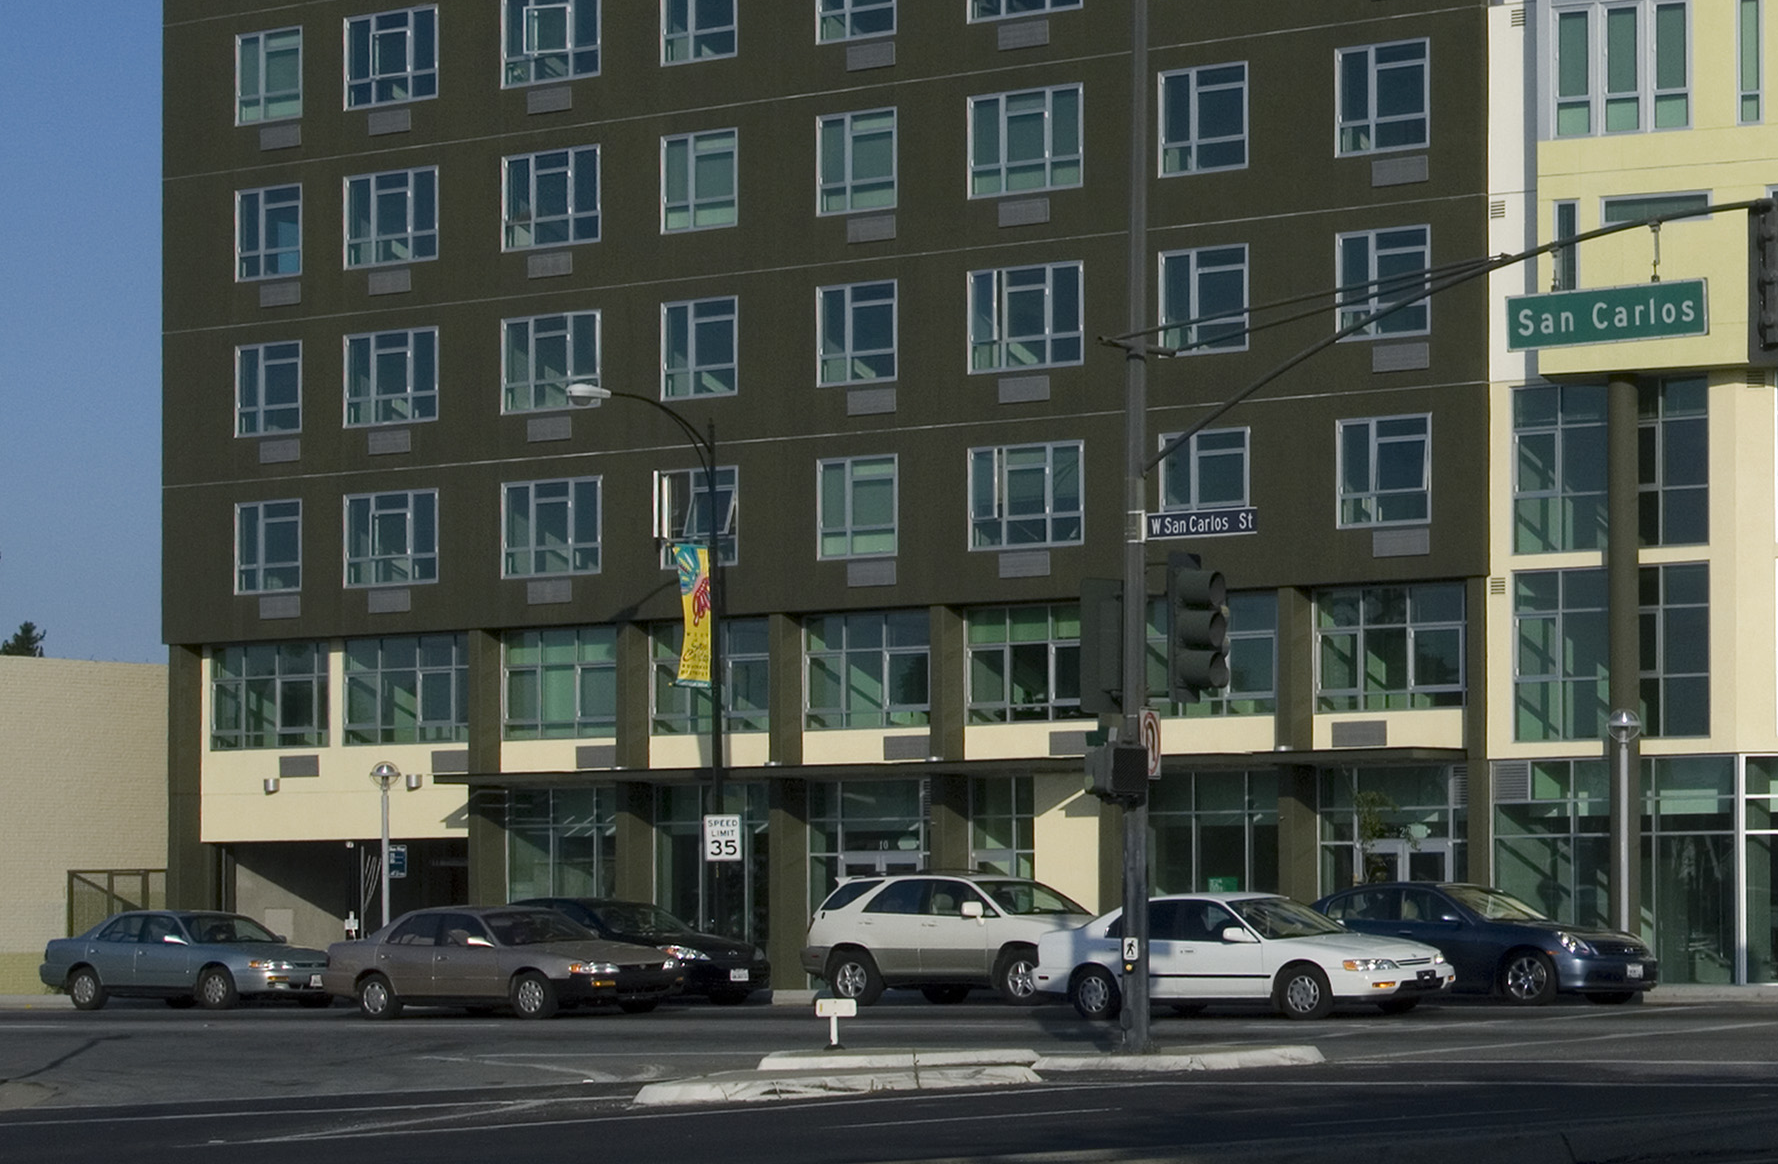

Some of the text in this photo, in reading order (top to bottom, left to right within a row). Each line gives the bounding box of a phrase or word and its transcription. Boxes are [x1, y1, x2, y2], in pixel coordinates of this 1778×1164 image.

[1518, 297, 1695, 337] San Carlos
[1151, 512, 1253, 535] W San Carlos St
[708, 819, 738, 827] SPEED
[711, 829, 735, 837] LIMIT
[710, 839, 737, 856] 35
